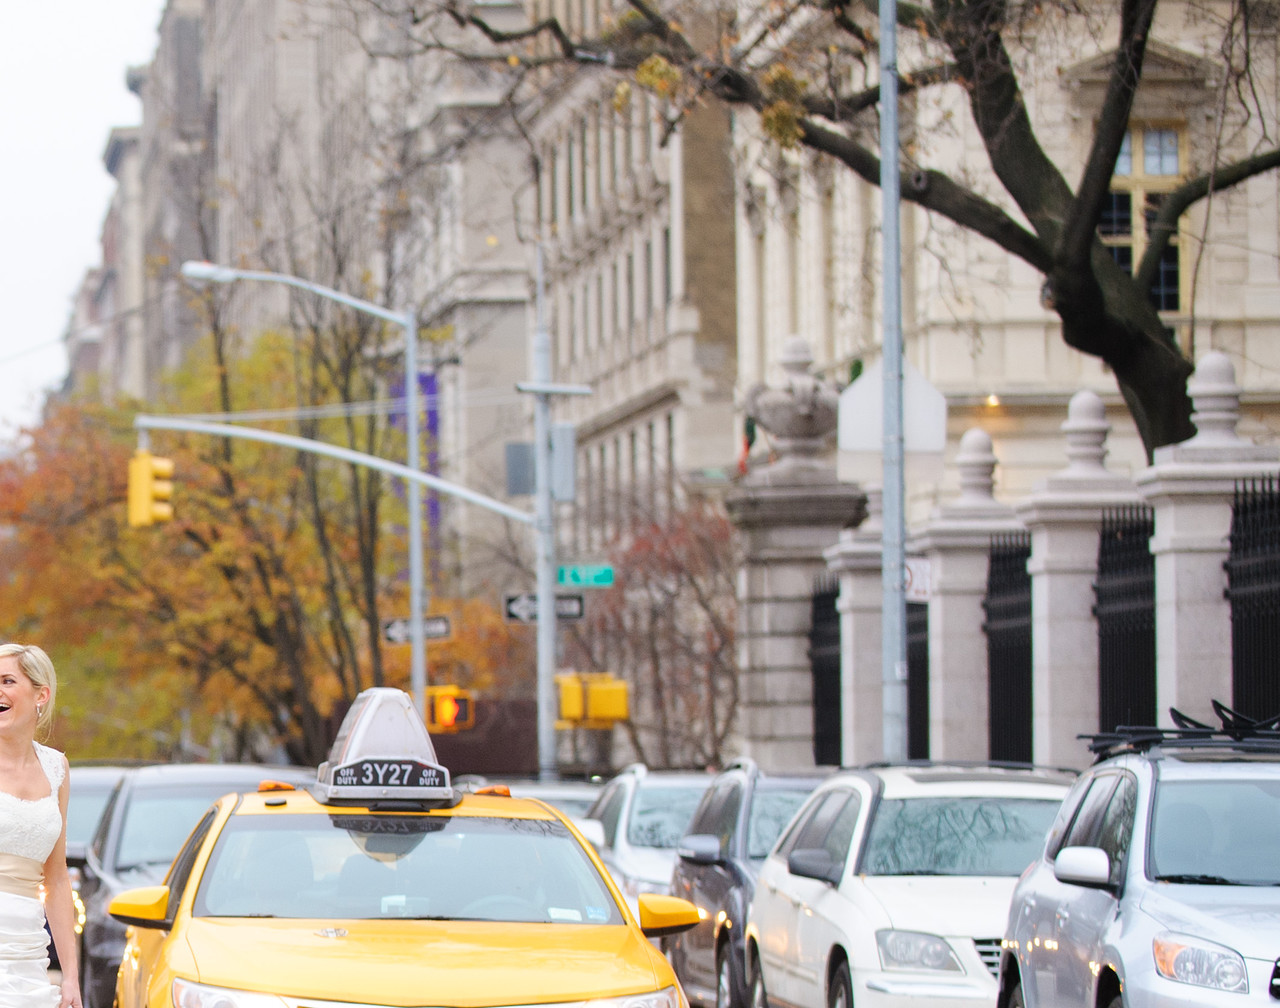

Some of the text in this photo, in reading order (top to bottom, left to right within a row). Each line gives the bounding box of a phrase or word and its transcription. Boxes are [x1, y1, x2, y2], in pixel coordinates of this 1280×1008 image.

[340, 768, 355, 777] OFF
[361, 763, 413, 785] 3Y27
[422, 769, 437, 777] OFF
[337, 776, 358, 785] DUTY
[419, 777, 439, 786] DUTY
